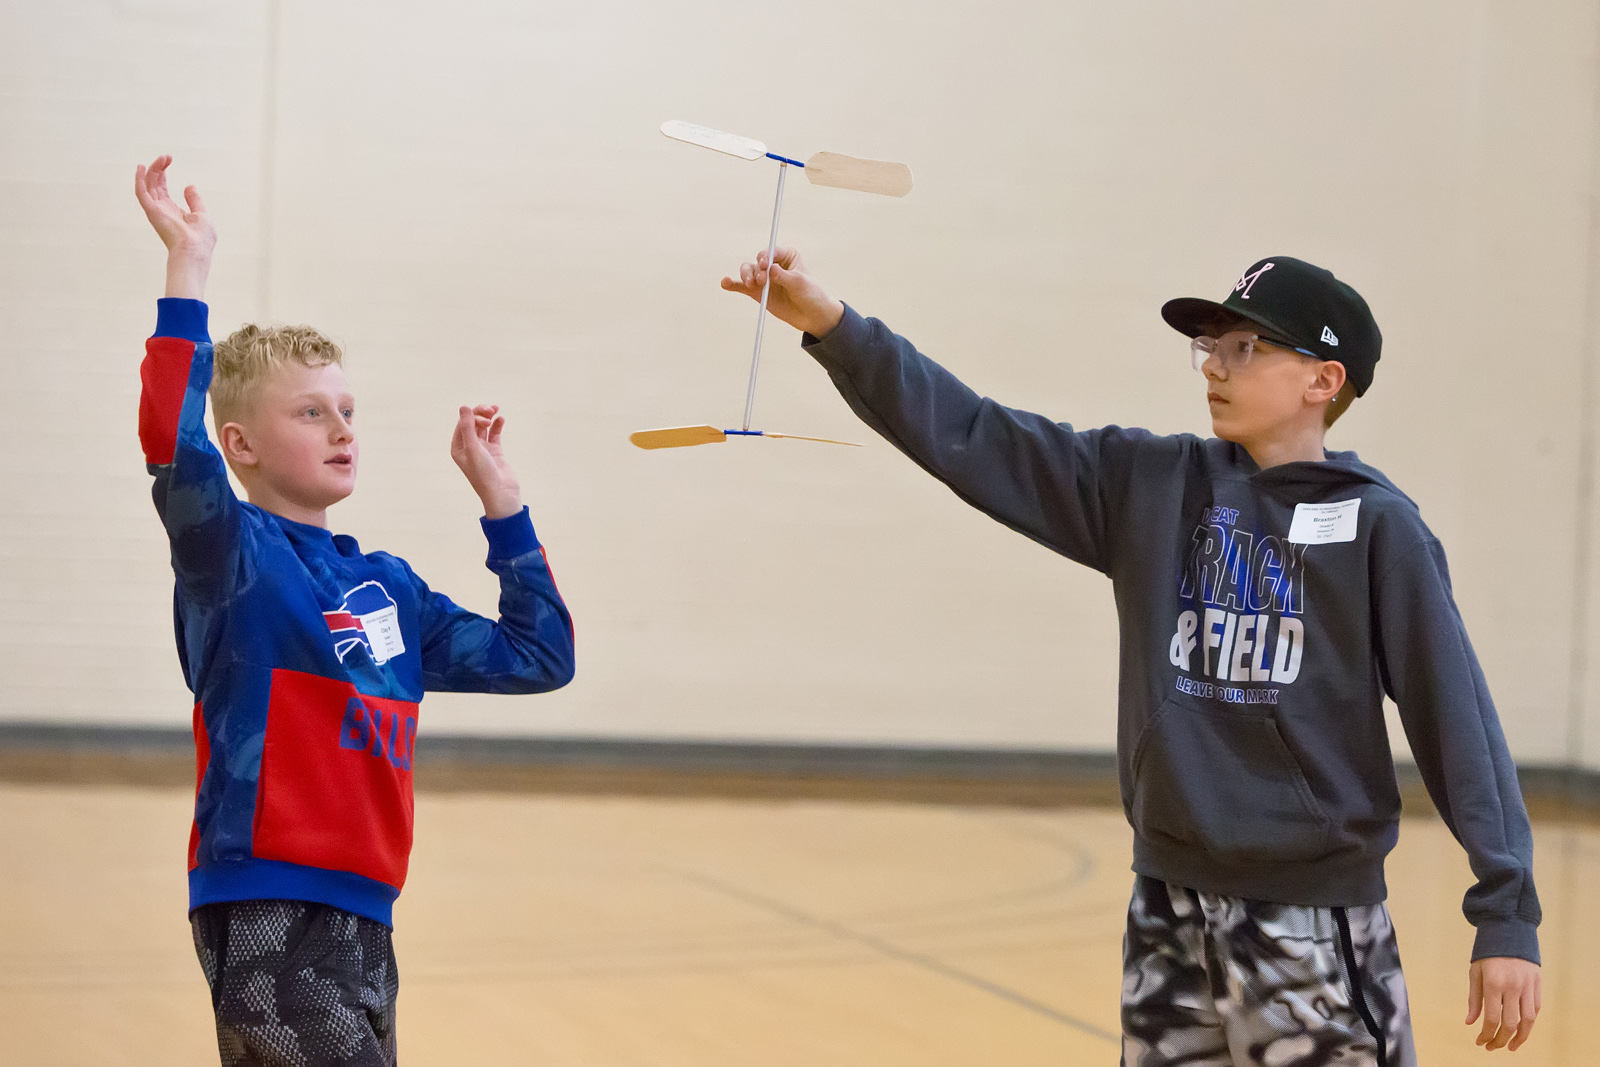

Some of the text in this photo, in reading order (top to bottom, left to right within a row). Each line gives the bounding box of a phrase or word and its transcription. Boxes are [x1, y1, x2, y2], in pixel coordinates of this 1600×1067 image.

[1169, 607, 1305, 685] & FIELD
[1175, 675, 1214, 698] LEAVE
[1214, 686, 1245, 703] OUR
